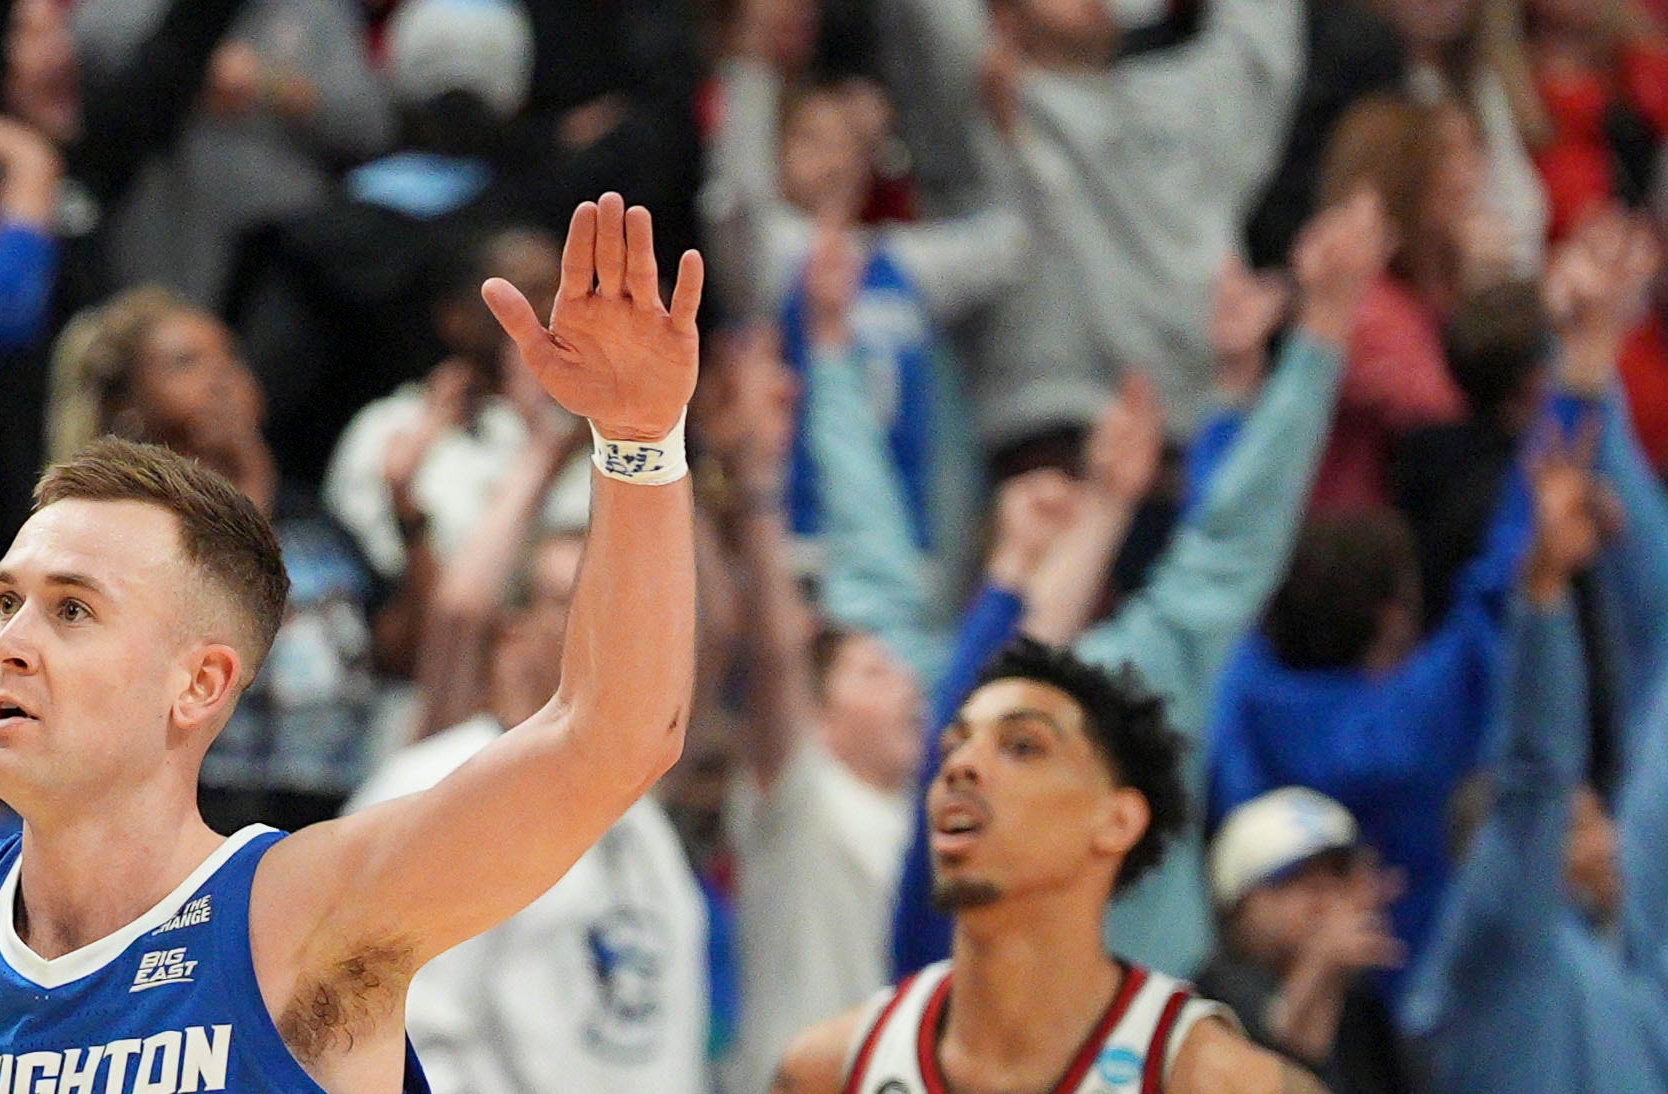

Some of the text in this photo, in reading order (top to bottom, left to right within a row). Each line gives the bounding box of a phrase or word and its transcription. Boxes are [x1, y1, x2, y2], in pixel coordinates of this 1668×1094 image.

[183, 894, 212, 914] THE
[151, 907, 212, 936] HANGE
[139, 947, 188, 970] BIG
[133, 960, 199, 985] EAST
